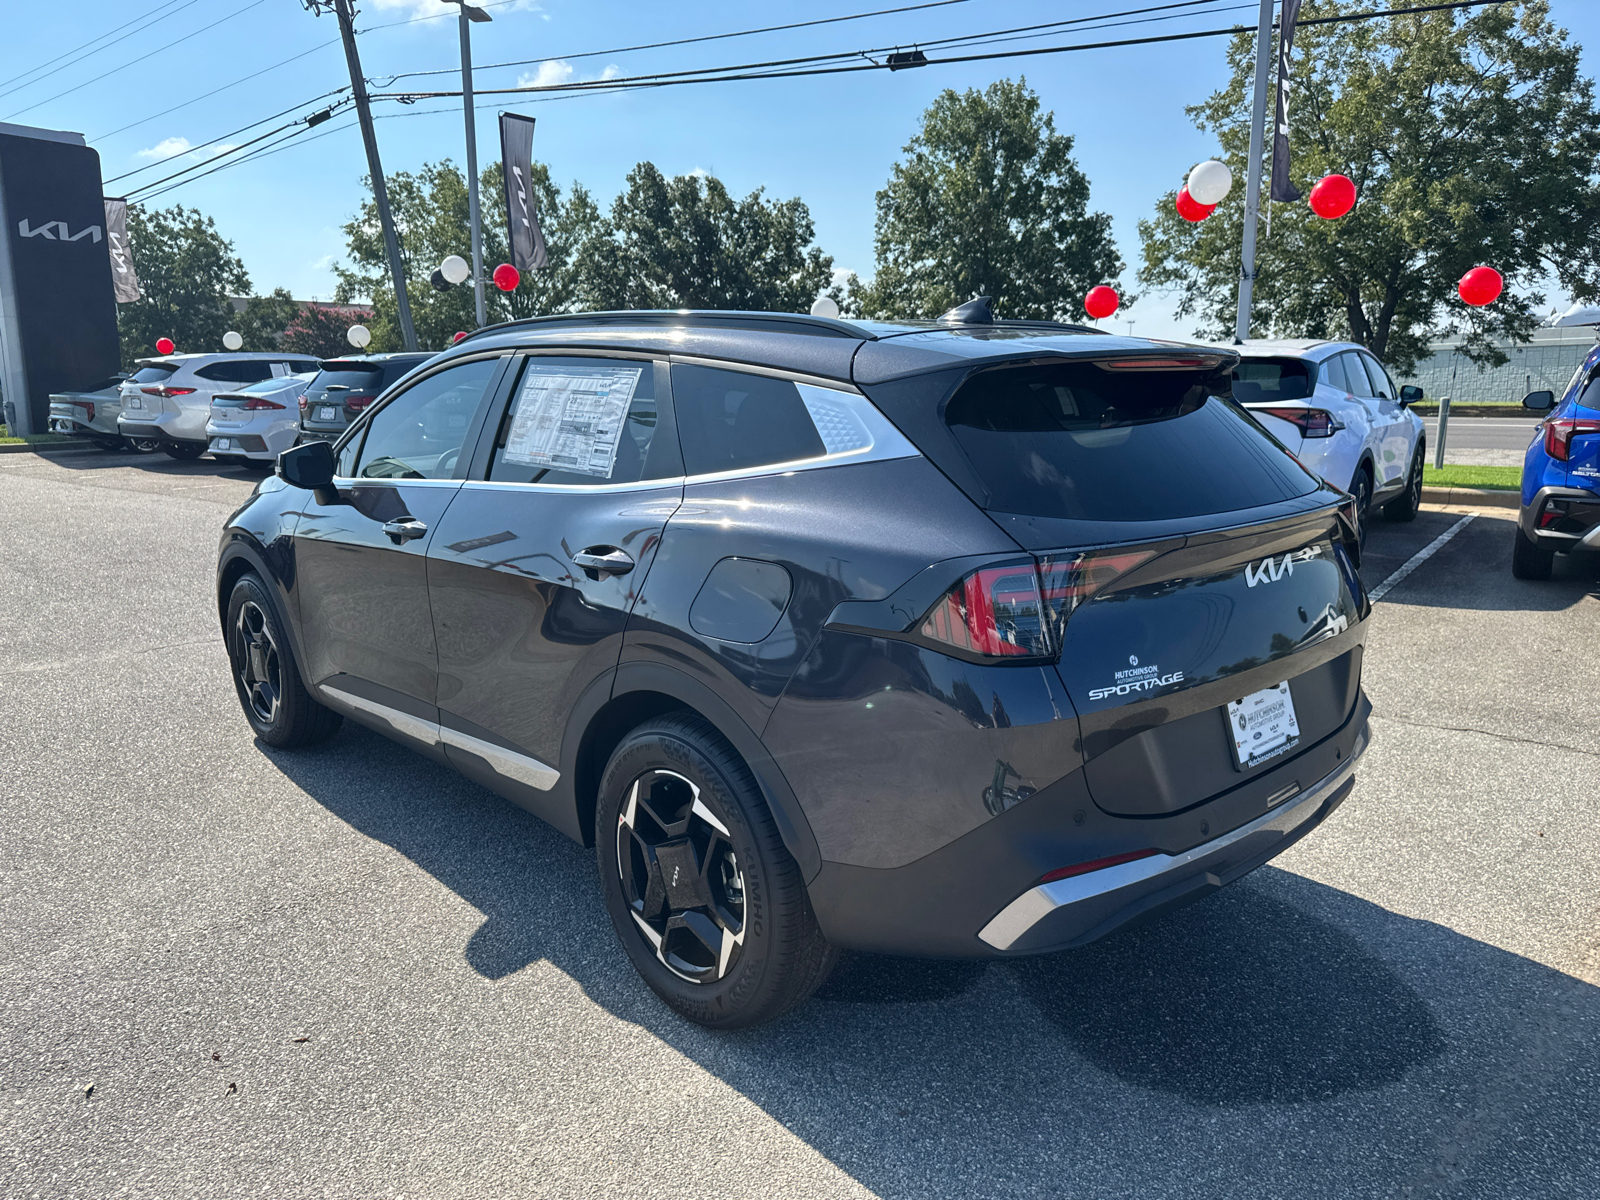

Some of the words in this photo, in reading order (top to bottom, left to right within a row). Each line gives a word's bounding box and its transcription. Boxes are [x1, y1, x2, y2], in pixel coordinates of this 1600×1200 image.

[18, 218, 102, 244] KIA
[1245, 553, 1293, 588] KIA
[1088, 671, 1184, 700] SPORTAGE
[1115, 665, 1159, 680] HUTCHINSON
[1247, 699, 1286, 725] HUTCHINSON
[743, 847, 764, 938] KUMHO
